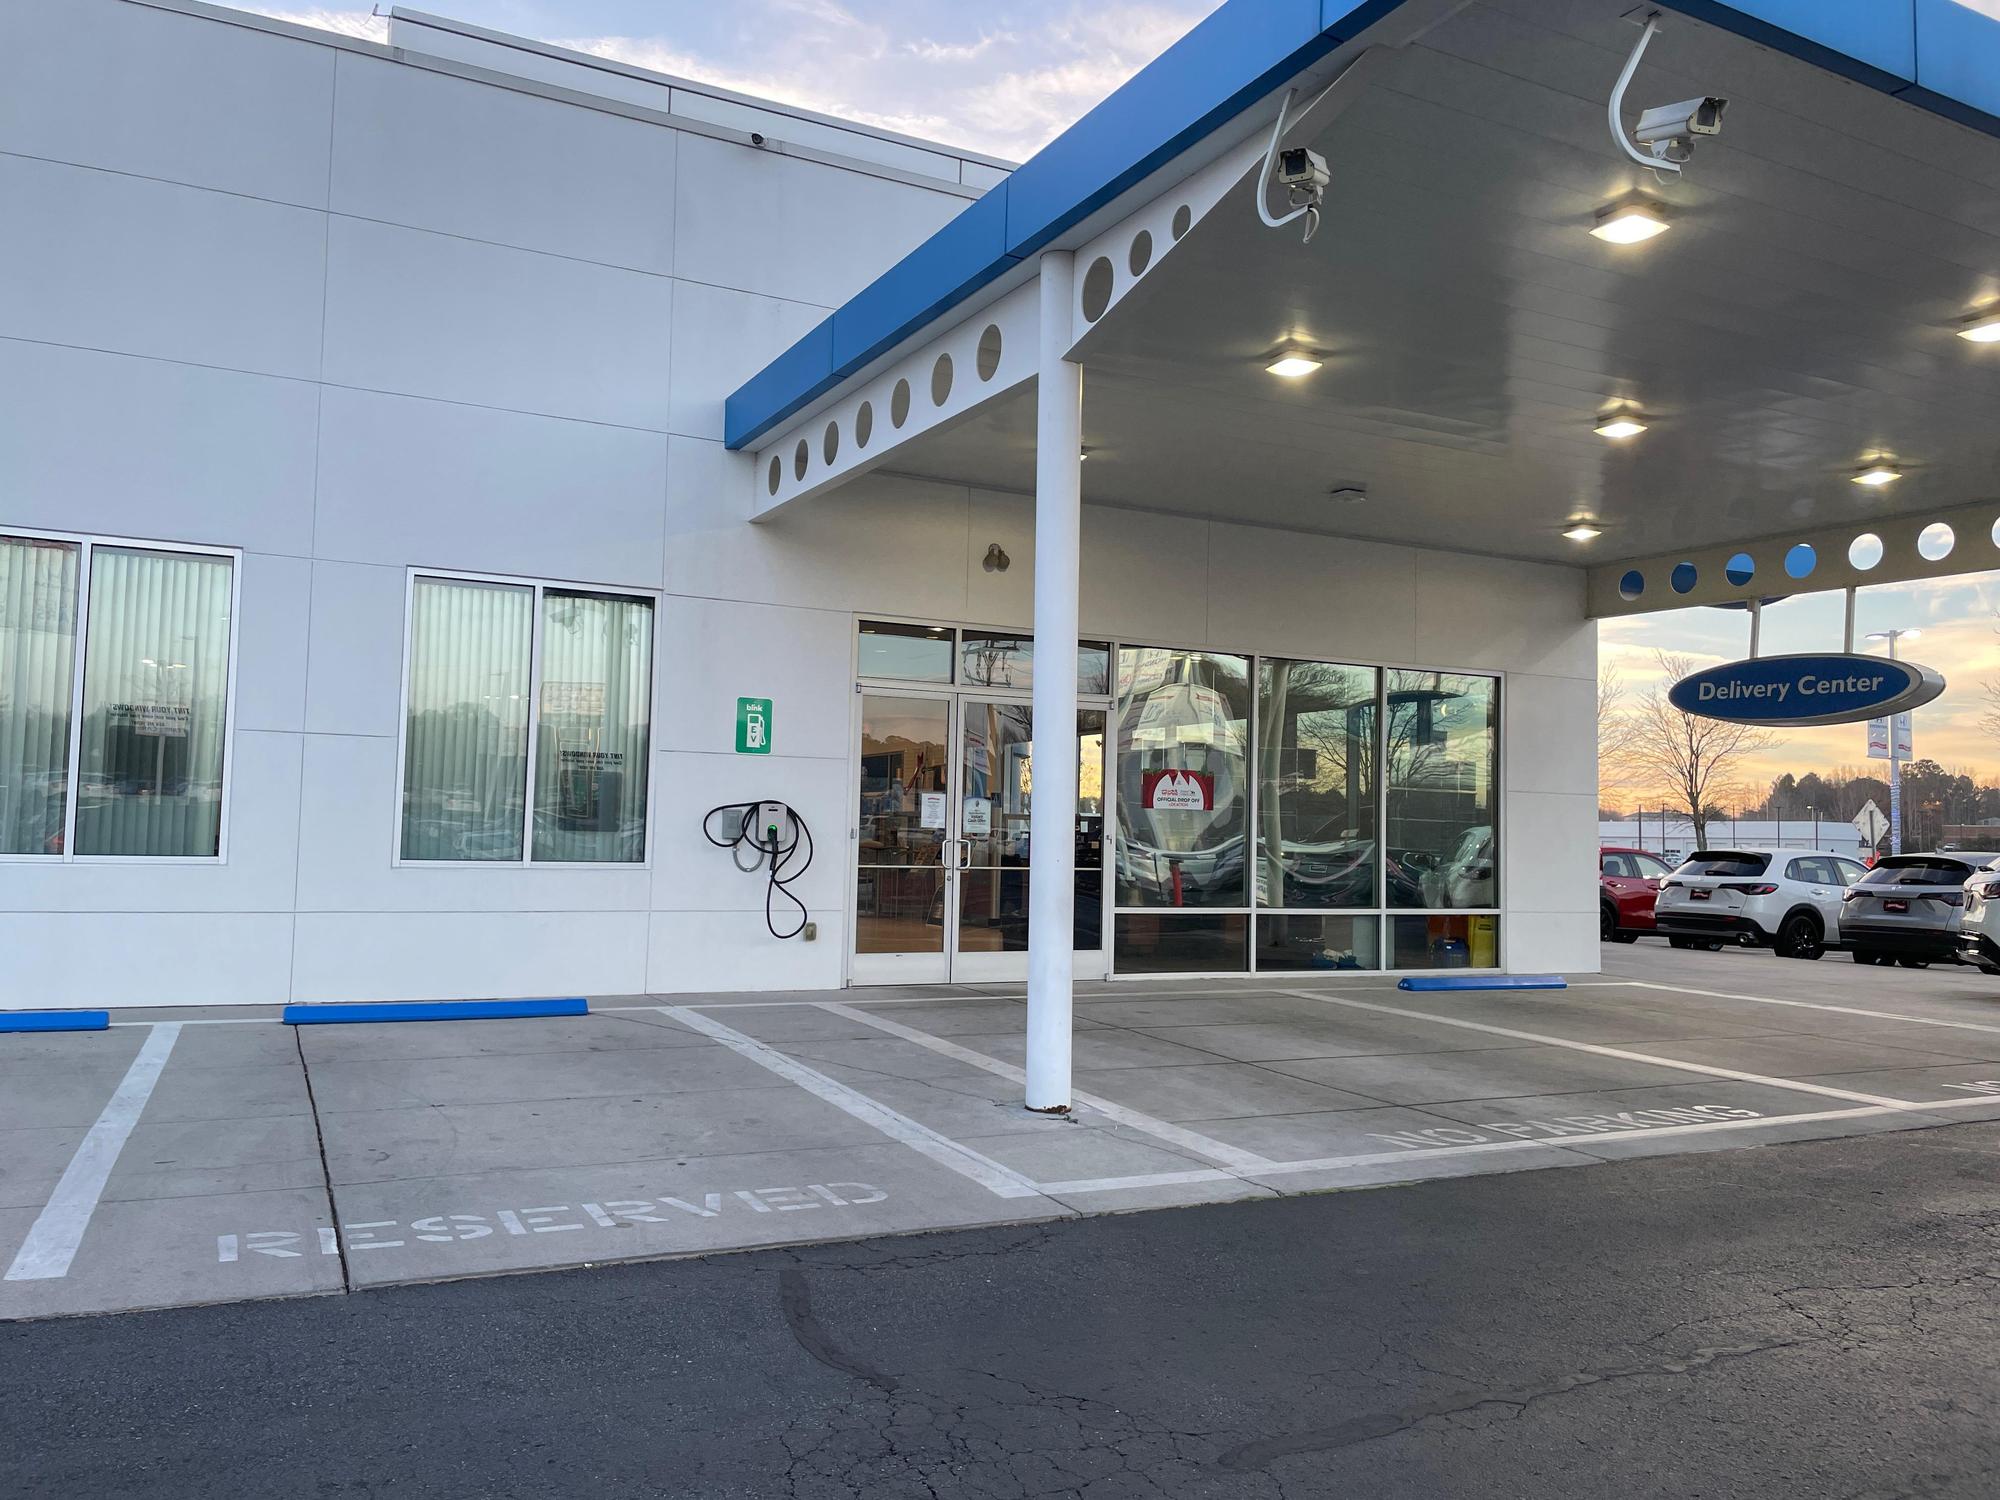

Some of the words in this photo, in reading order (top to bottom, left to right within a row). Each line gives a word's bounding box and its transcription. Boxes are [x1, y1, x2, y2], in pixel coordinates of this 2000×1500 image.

[1699, 680, 1791, 702] Delivery
[1798, 675, 1884, 695] Center
[1365, 1127, 1488, 1149] NO
[1478, 1104, 1765, 1139] PARKING
[216, 1182, 889, 1262] RESERVED
